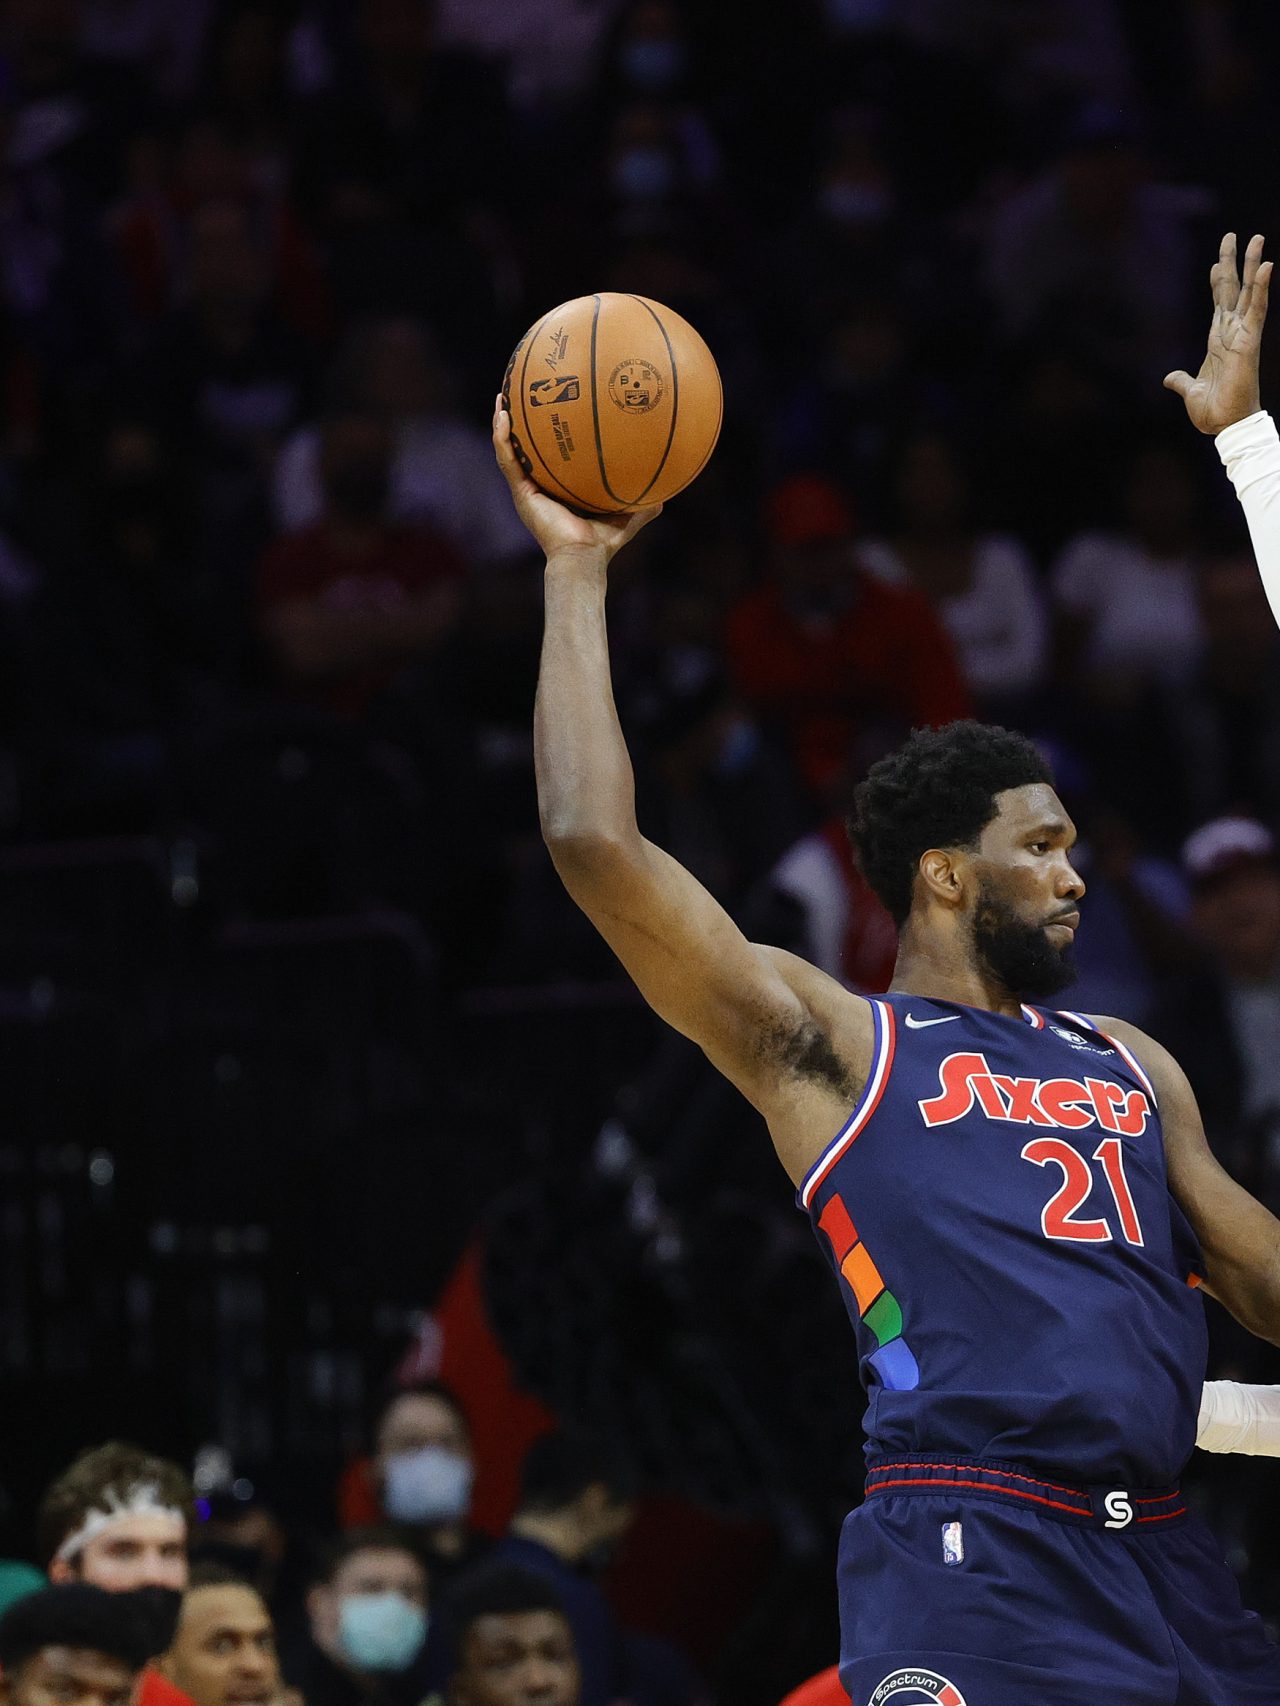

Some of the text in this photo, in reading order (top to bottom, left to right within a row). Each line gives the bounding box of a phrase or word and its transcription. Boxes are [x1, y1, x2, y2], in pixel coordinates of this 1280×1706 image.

[918, 1052, 1151, 1137] Sixers
[1021, 1137, 1145, 1248] 21
[875, 1673, 938, 1702] Spectrum
